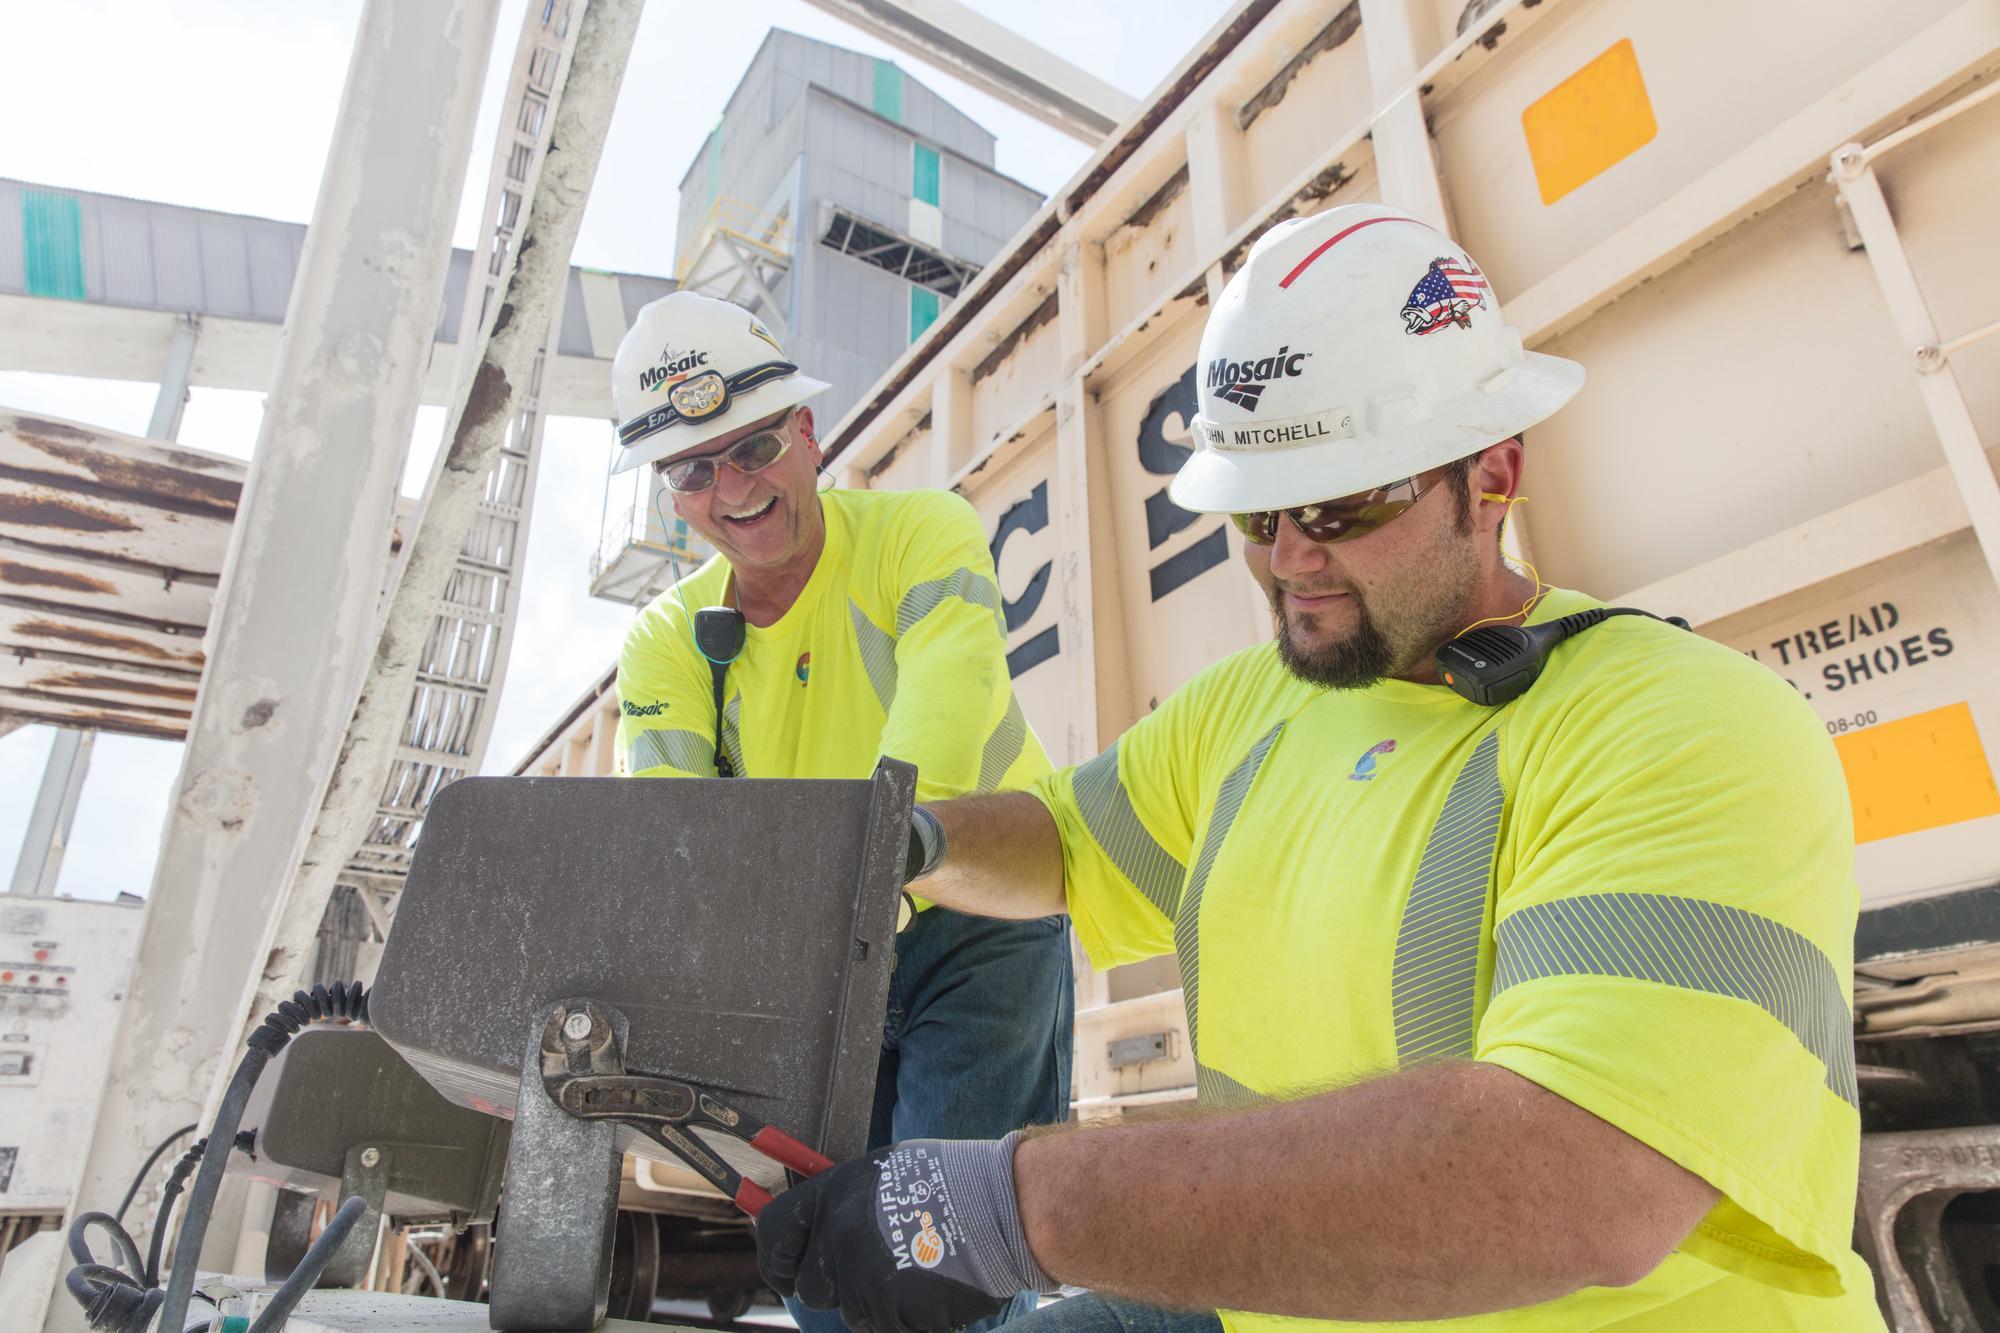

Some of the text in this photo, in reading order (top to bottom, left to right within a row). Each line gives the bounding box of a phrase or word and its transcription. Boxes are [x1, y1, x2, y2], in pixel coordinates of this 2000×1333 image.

[639, 349, 709, 391] Mosaic
[1234, 421, 1330, 445] MITCHELL
[1771, 602, 1899, 665] TREAD
[1823, 627, 1954, 691] SHOES
